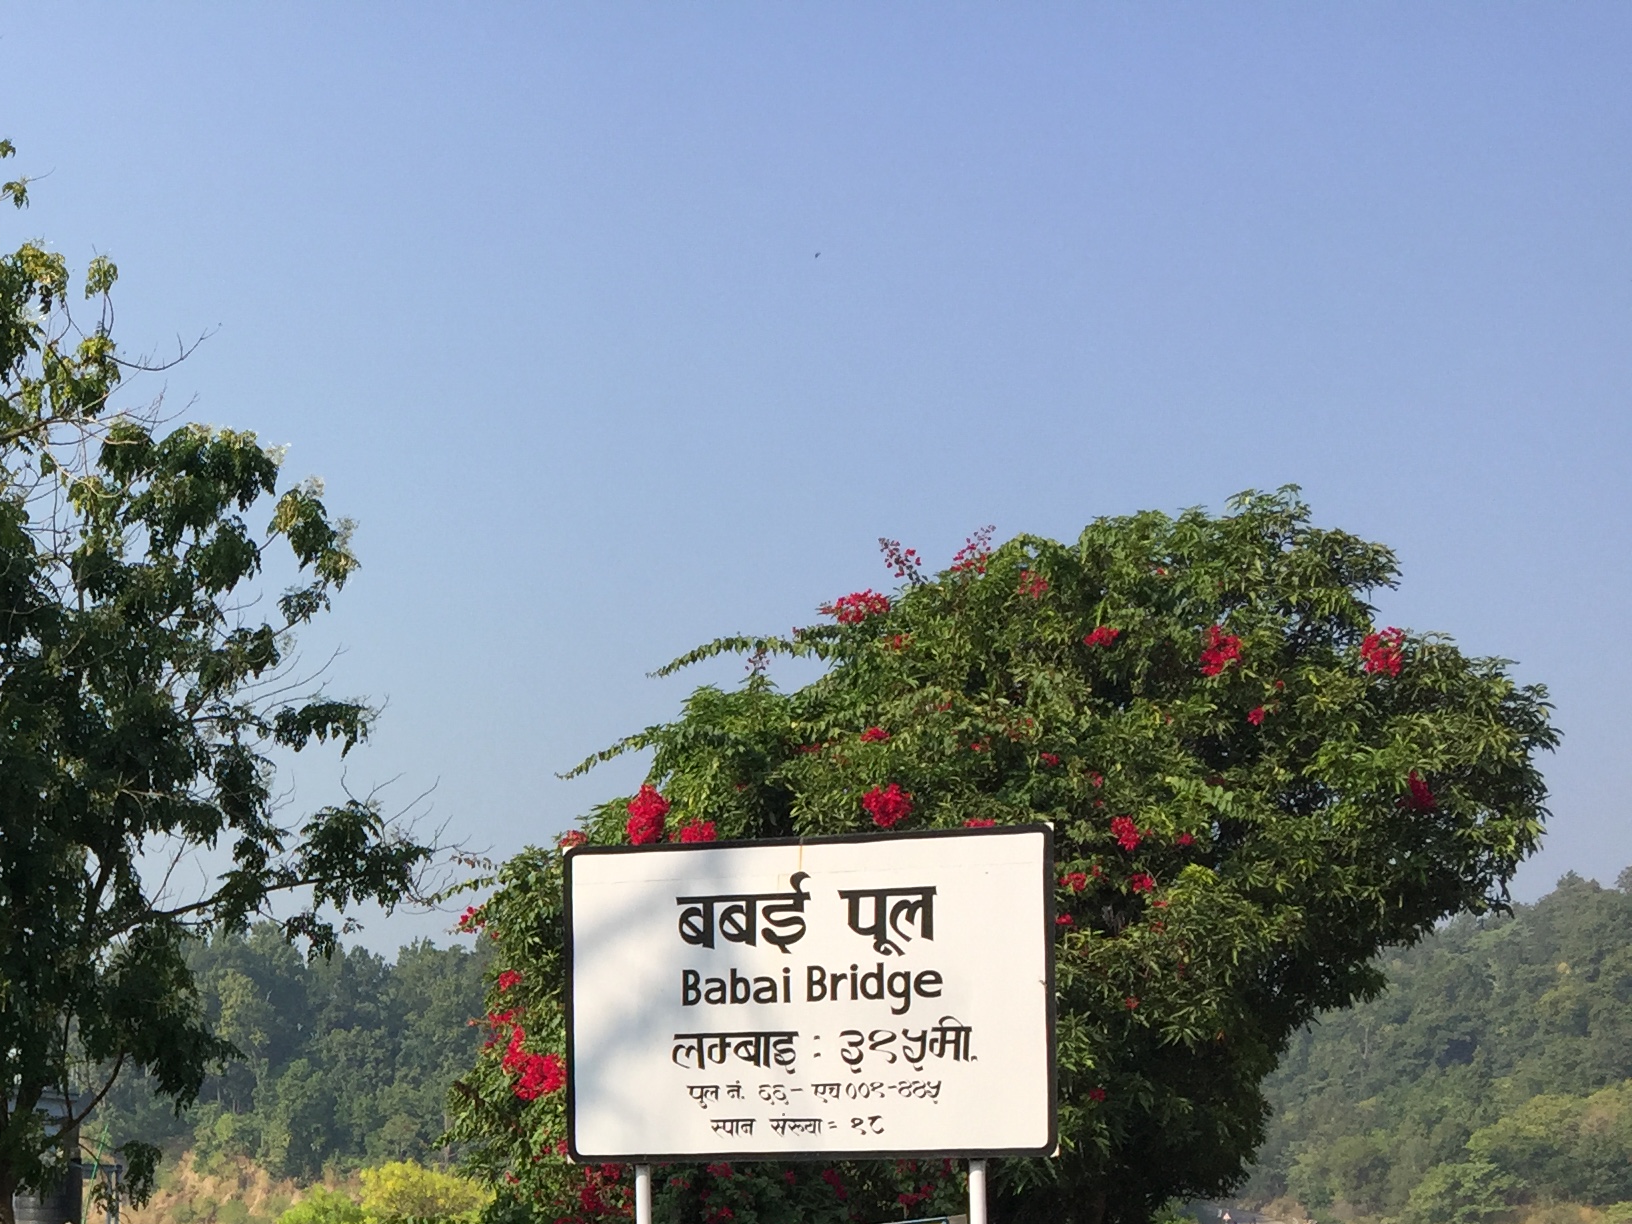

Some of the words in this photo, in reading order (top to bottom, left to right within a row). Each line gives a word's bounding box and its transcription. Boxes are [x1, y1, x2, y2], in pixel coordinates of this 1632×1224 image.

[675, 871, 812, 954] बबई
[837, 885, 937, 957] पूल
[681, 966, 791, 1007] Babai
[806, 962, 943, 1016] Bridge
[686, 1085, 720, 1110] पुल
[710, 1118, 757, 1136] स्पान
